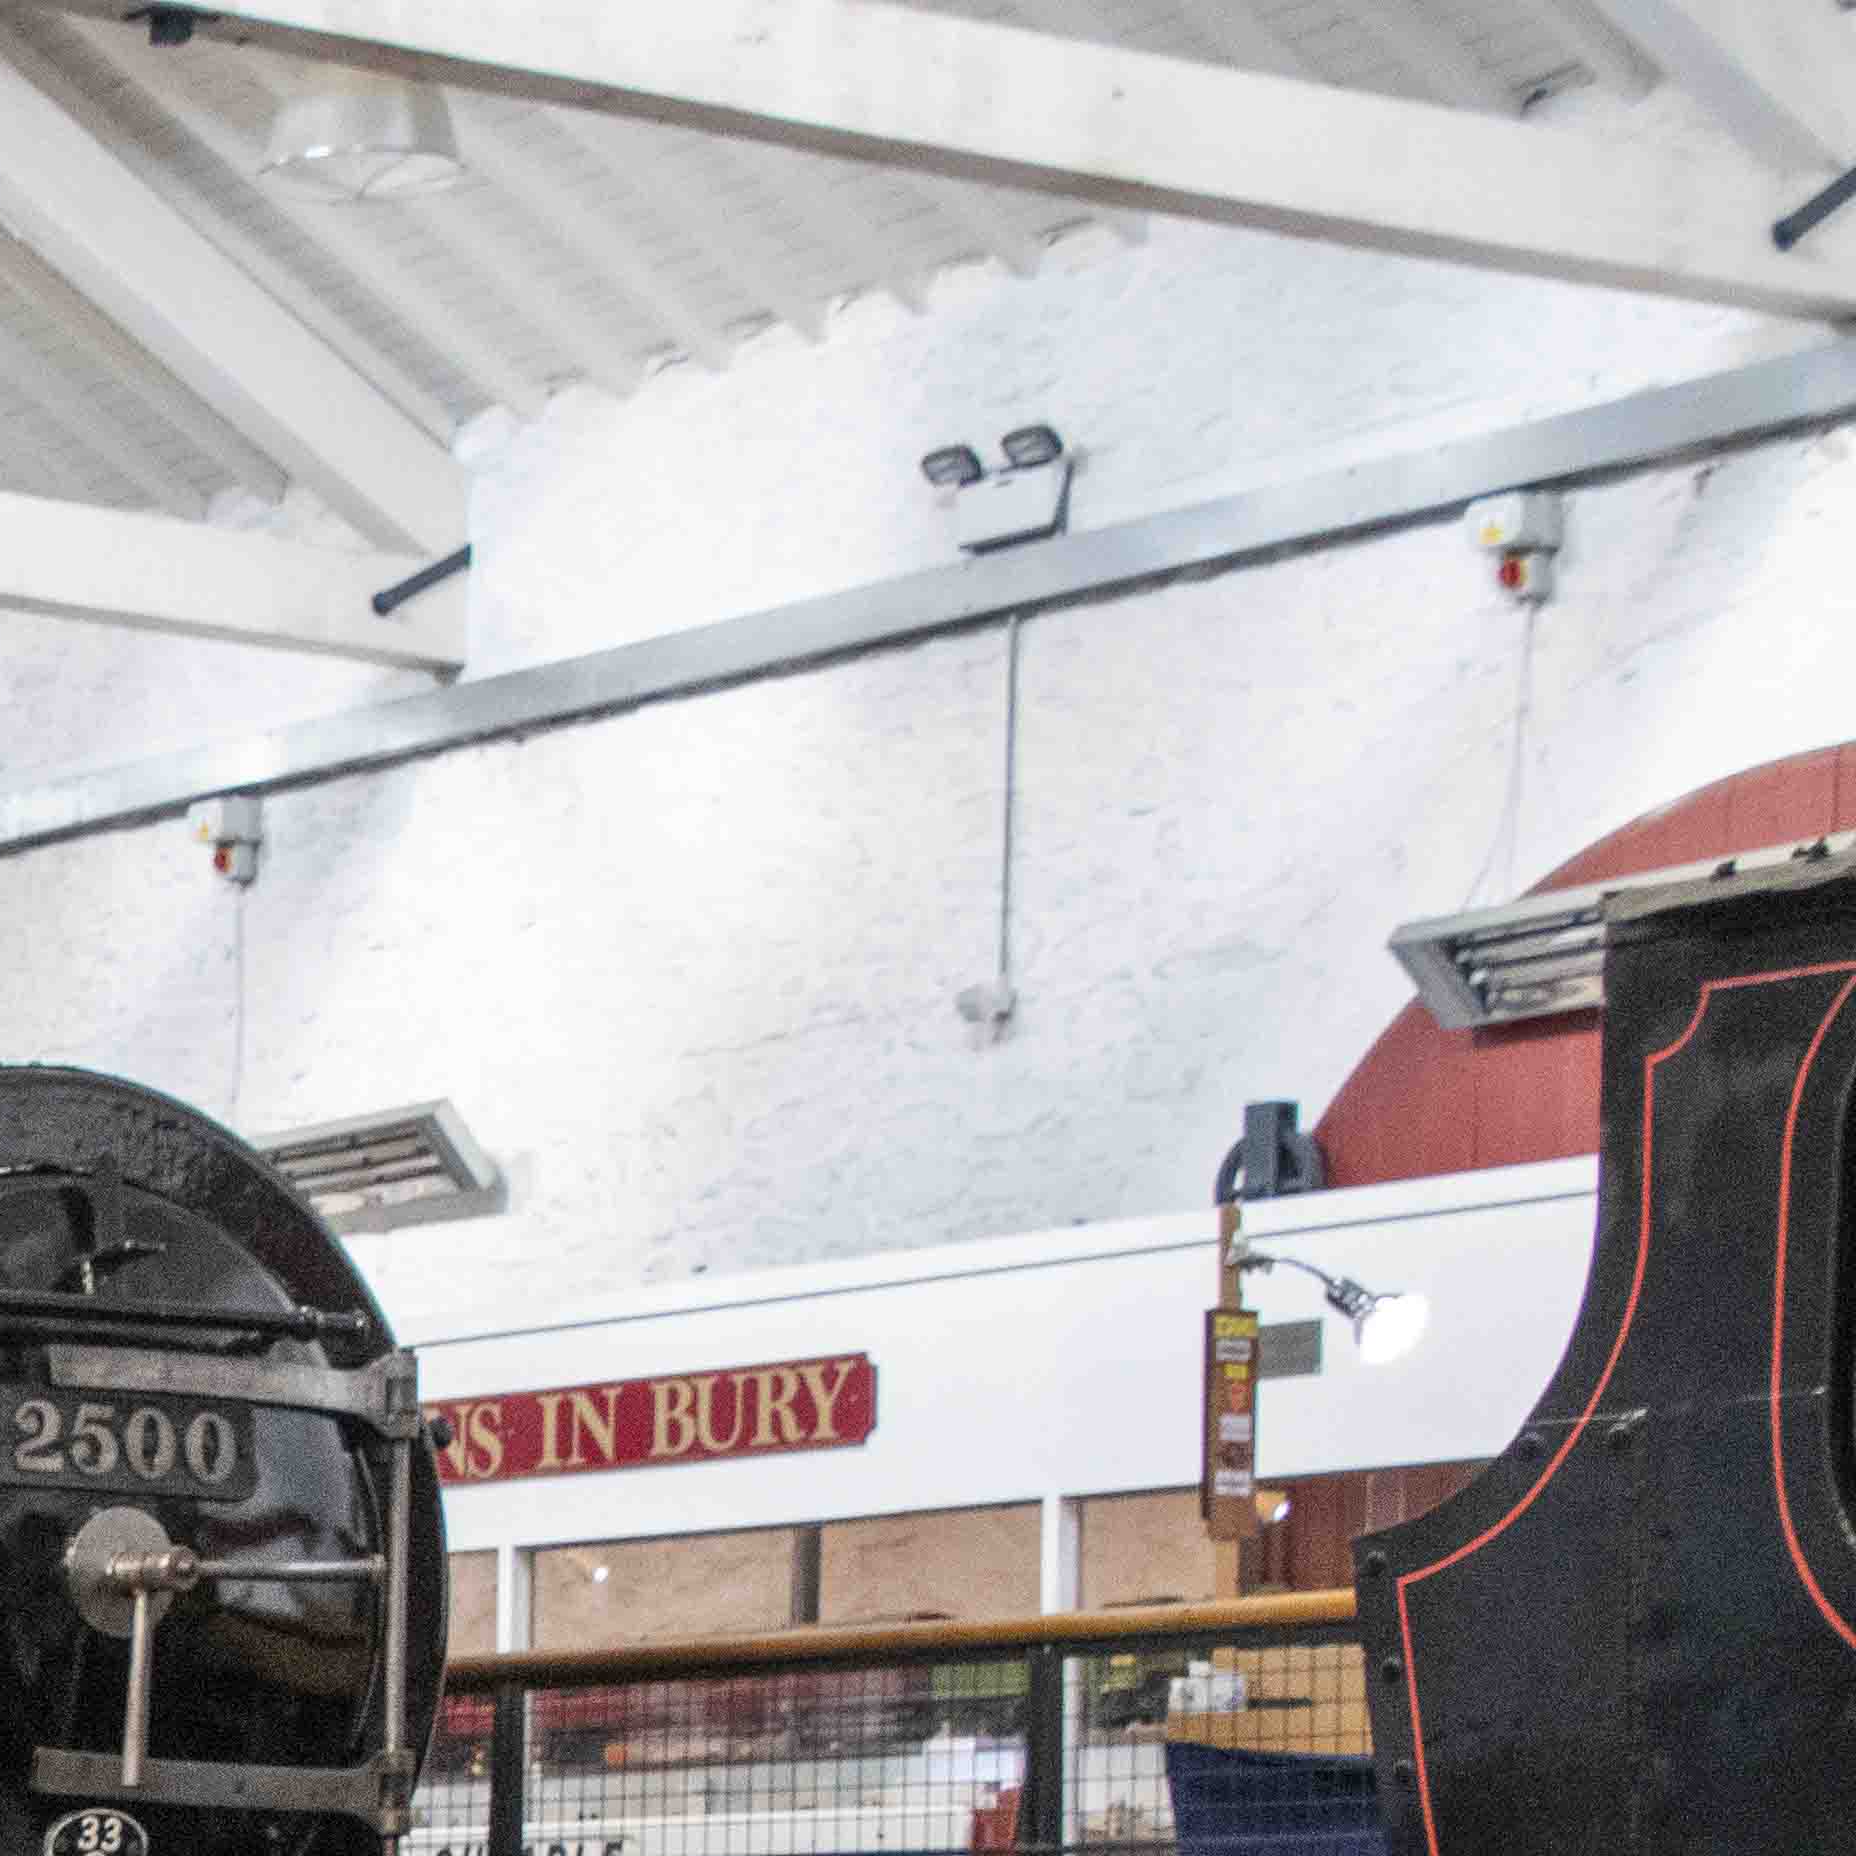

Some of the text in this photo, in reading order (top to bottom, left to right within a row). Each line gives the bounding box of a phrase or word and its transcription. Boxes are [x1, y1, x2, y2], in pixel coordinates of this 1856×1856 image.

[14, 1400, 237, 1483] 2500
[536, 1388, 623, 1470] IN
[649, 1358, 857, 1458] BURY
[77, 1817, 122, 1853] 33
